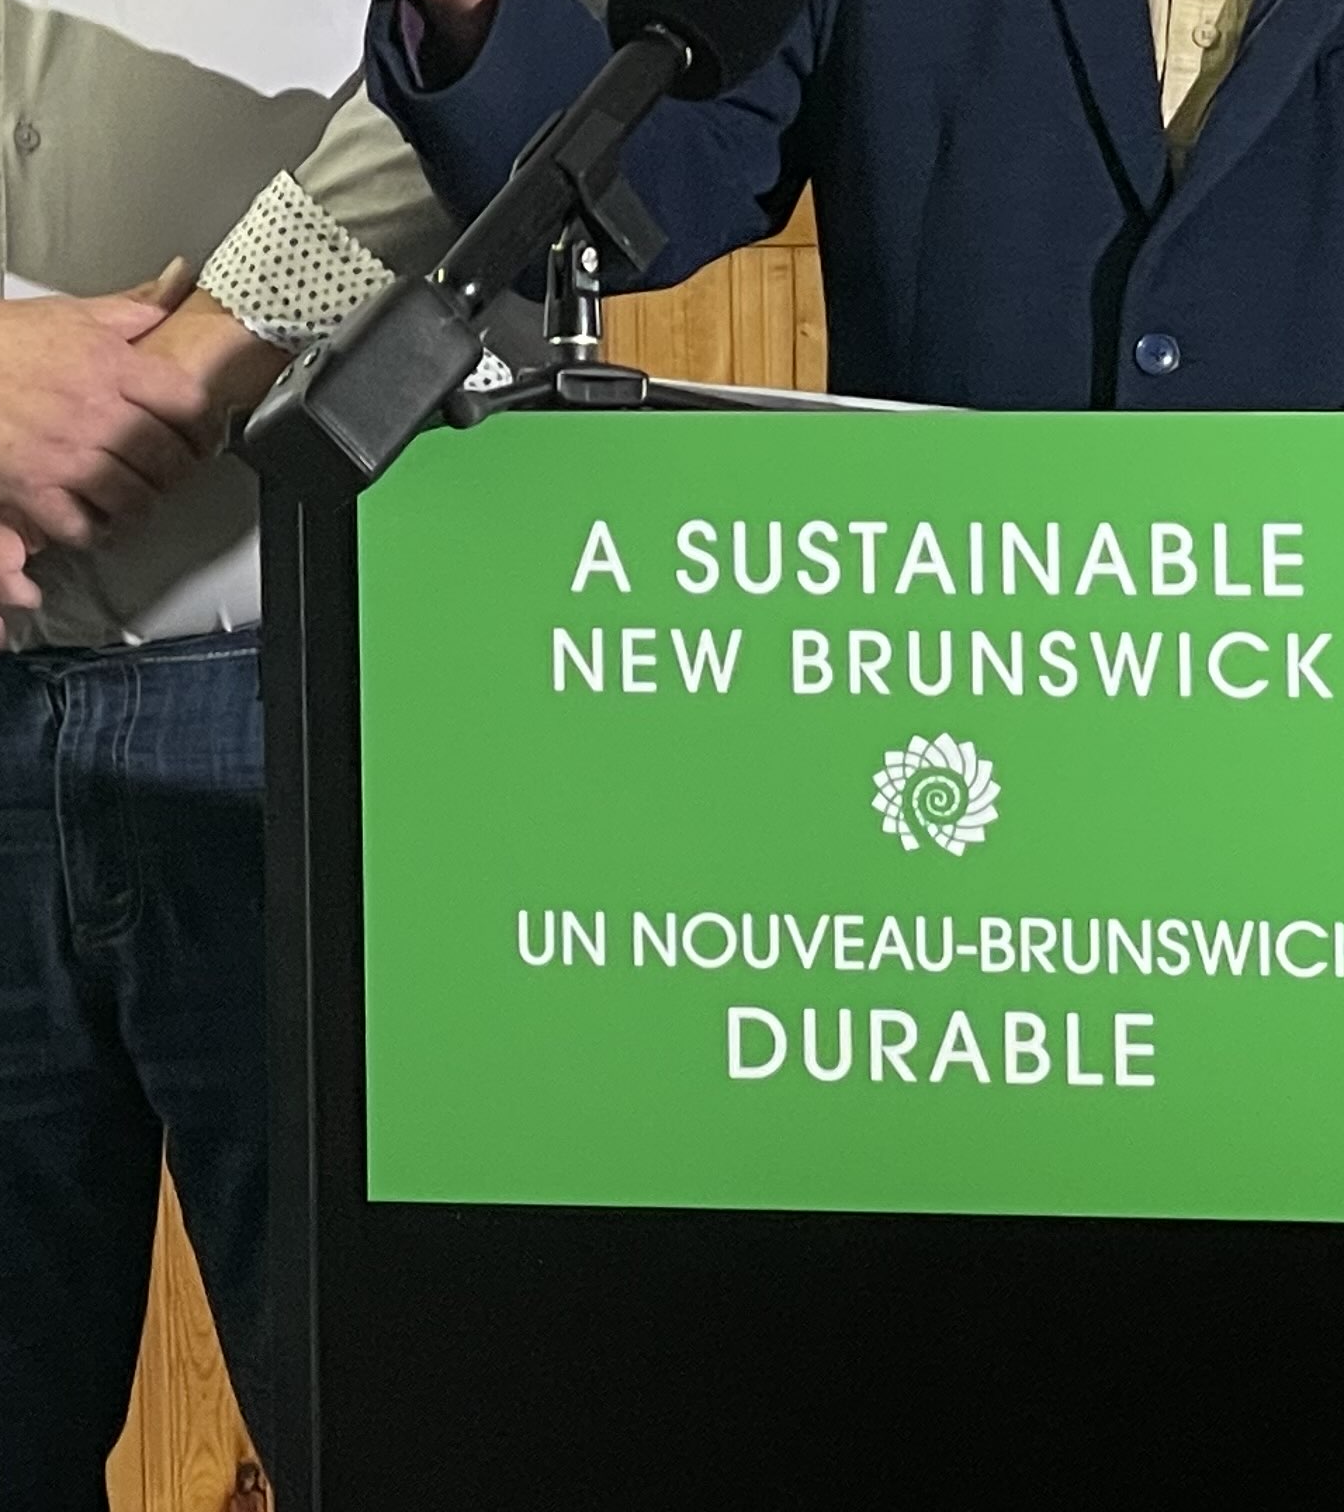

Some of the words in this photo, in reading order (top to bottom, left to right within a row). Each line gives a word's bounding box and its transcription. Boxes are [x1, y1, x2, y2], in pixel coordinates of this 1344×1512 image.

[569, 519, 633, 594] A
[674, 518, 1307, 598] SUSTAINABLE
[552, 626, 744, 695] NEW
[791, 628, 1336, 701] BRUNSWICK
[517, 908, 607, 968] UN
[726, 1005, 1158, 1088] DURABLE
